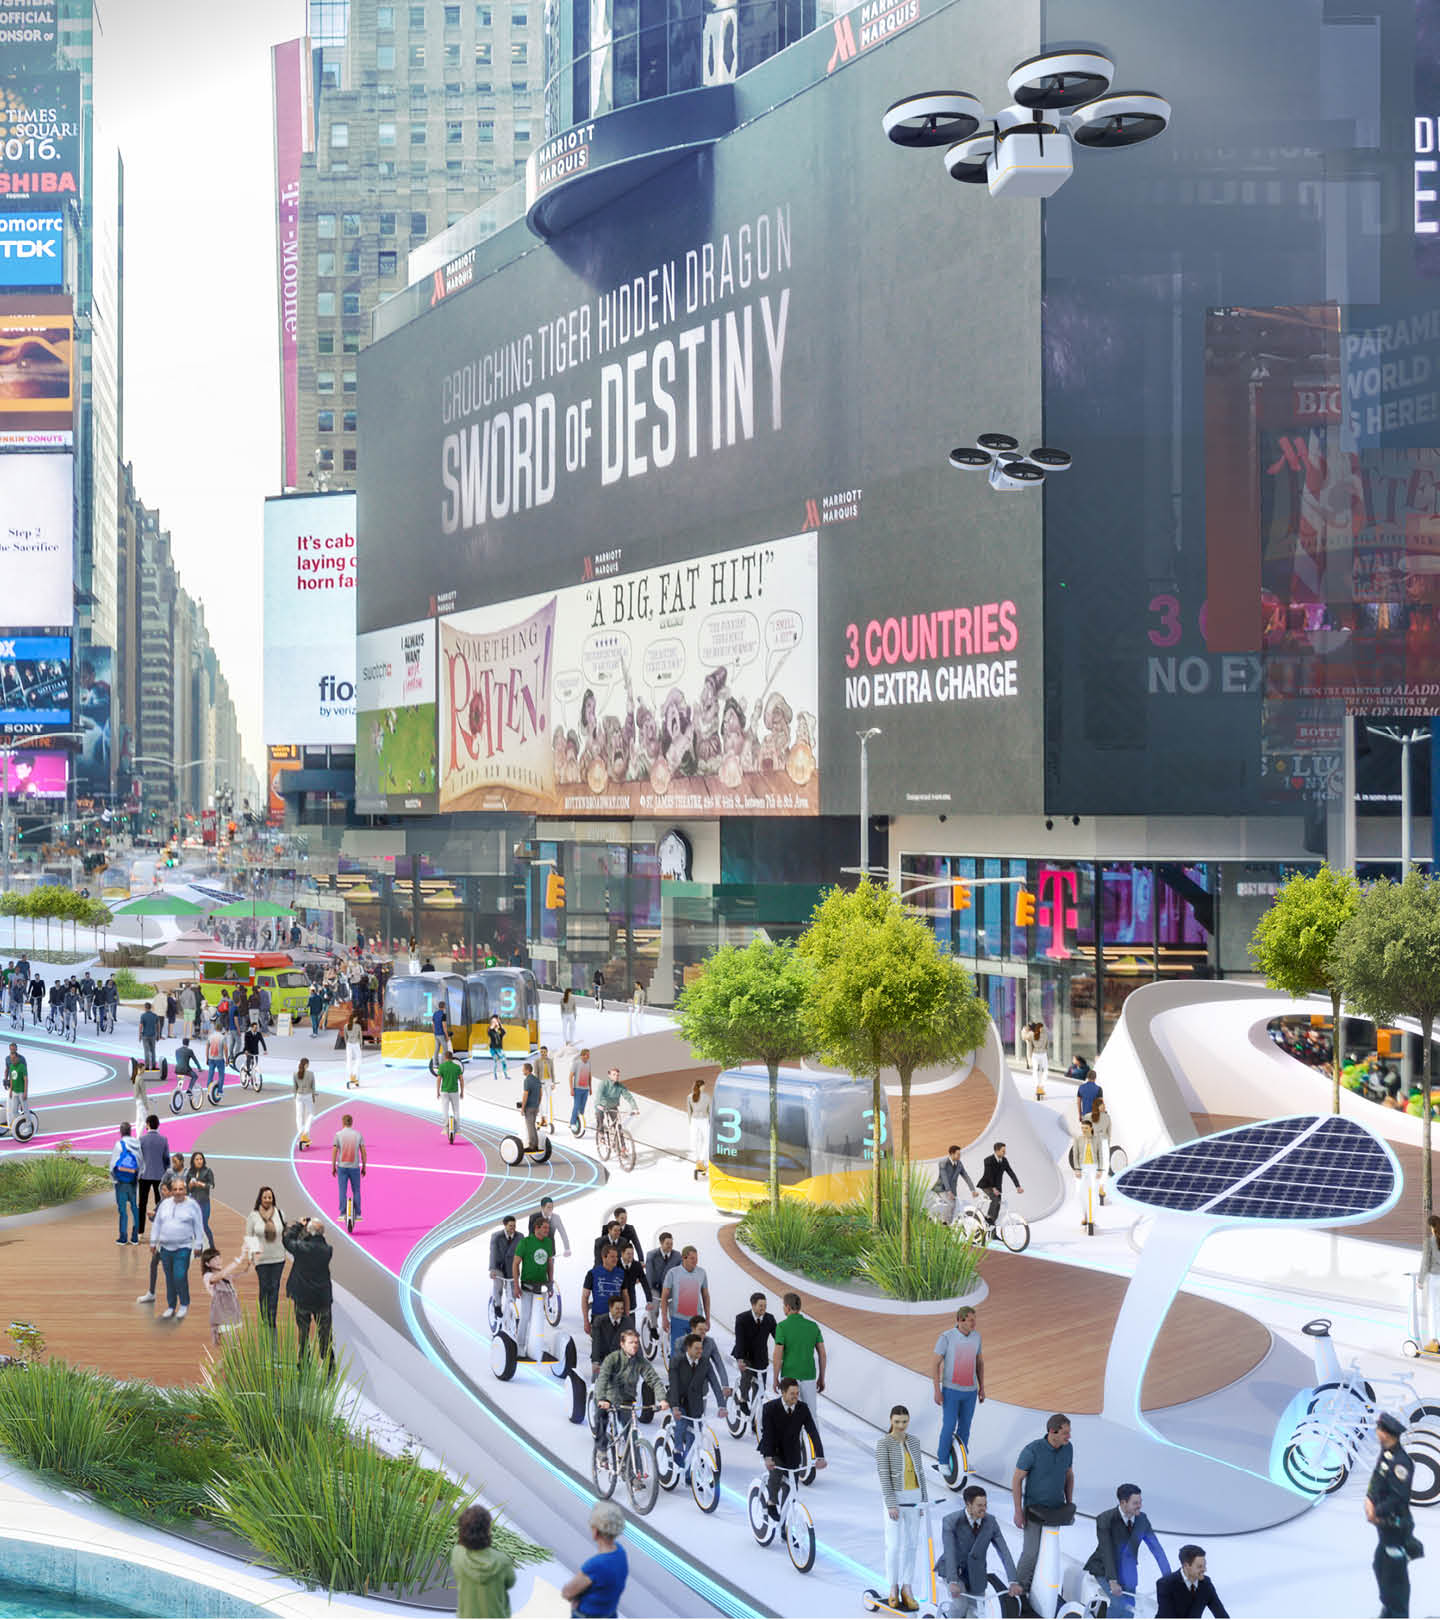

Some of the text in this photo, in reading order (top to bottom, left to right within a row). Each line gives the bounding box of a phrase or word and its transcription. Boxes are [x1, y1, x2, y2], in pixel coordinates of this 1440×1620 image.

[0, 12, 54, 24] OFFICIAL
[862, 0, 918, 47] MARQUIS
[6, 108, 57, 123] TIMES
[538, 124, 595, 167] MARRIOTT
[538, 149, 587, 188] MARQUIS
[446, 248, 477, 278] MARRIOTT
[446, 267, 473, 294] MARQUIS
[442, 203, 791, 425] CROUCHING TIGER HIDDEN DRAGON
[441, 288, 791, 535] SWORD OF DESTINY
[822, 488, 863, 509] MARRIOTT
[822, 503, 858, 523] MARQUIS
[8, 527, 32, 541] Step
[13, 541, 60, 553] Sacrifice
[297, 533, 355, 551] It's cab
[297, 555, 346, 573] laying
[594, 548, 622, 565] MARRIOTT
[594, 561, 619, 577] MARQUIS
[297, 575, 335, 591] horn
[613, 575, 654, 624] BIG,
[658, 563, 701, 616] FAT
[455, 621, 539, 664] SOMETHING
[846, 623, 858, 669] 3
[865, 600, 1018, 667] COUNTRIES
[846, 660, 1018, 709] NO EXTRA CHARGE
[1147, 655, 1210, 694] NO
[3, 723, 44, 733] SONY
[1037, 868, 1079, 960] T
[423, 992, 434, 1017] 1
[501, 986, 517, 1012] 3
[716, 1107, 743, 1144] 3
[861, 1108, 888, 1147] 3
[716, 1143, 738, 1158] line
